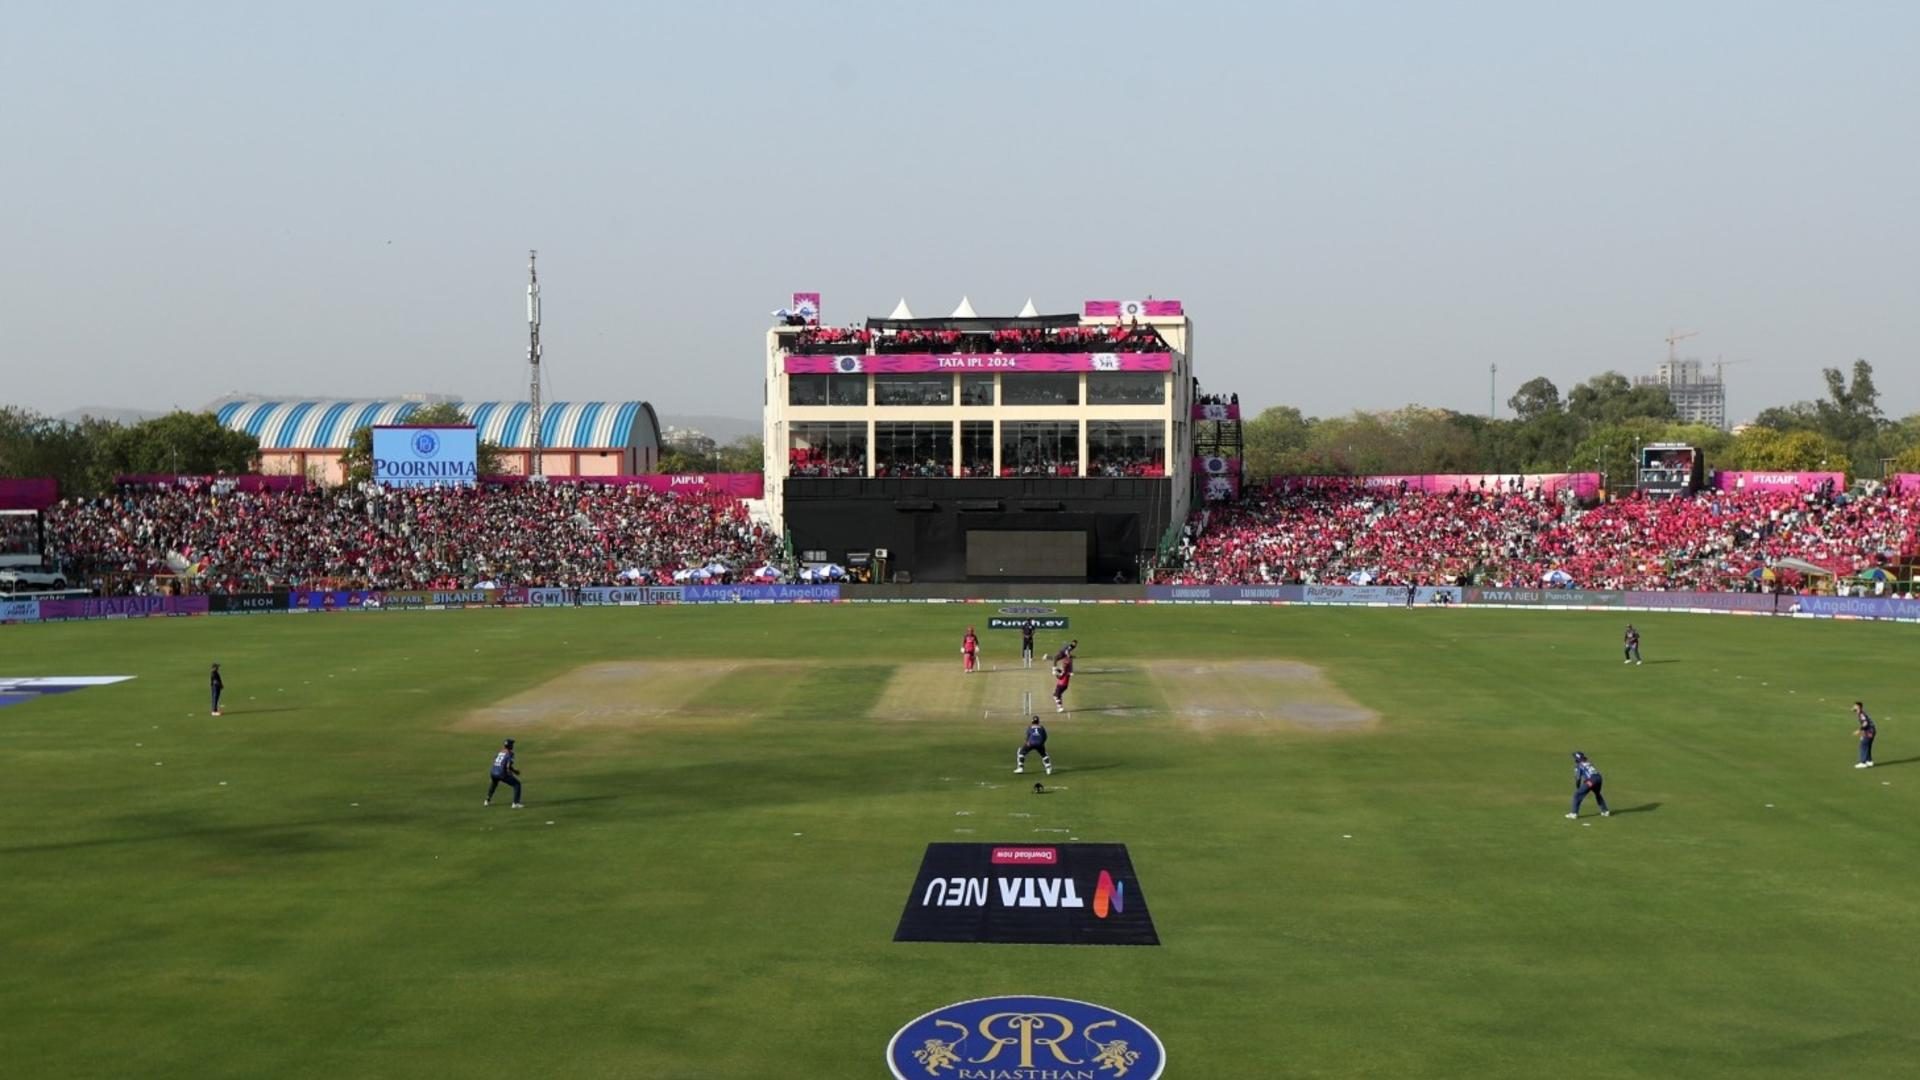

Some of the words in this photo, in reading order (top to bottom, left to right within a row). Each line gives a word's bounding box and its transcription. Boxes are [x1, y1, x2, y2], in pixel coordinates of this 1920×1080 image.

[937, 358, 964, 367] TATA
[967, 358, 984, 367] IPL
[987, 358, 1016, 367] 2024
[373, 458, 477, 477] POORNIMA
[671, 475, 705, 487] JAIPUR
[1752, 474, 1800, 486] #TATAIPL
[432, 592, 486, 603] BIKANER
[1481, 591, 1513, 600] TATA
[1515, 591, 1539, 601] NEU
[1545, 591, 1585, 600] Punch.ev
[243, 598, 274, 607] NEOM
[1812, 599, 1876, 613] AngelOne
[991, 619, 1064, 627] Punch.ev
[1014, 851, 1052, 860] Download
[922, 877, 989, 906] NEU
[997, 877, 1084, 907] TATA
[959, 1069, 1094, 1080] RAJASTHAN
